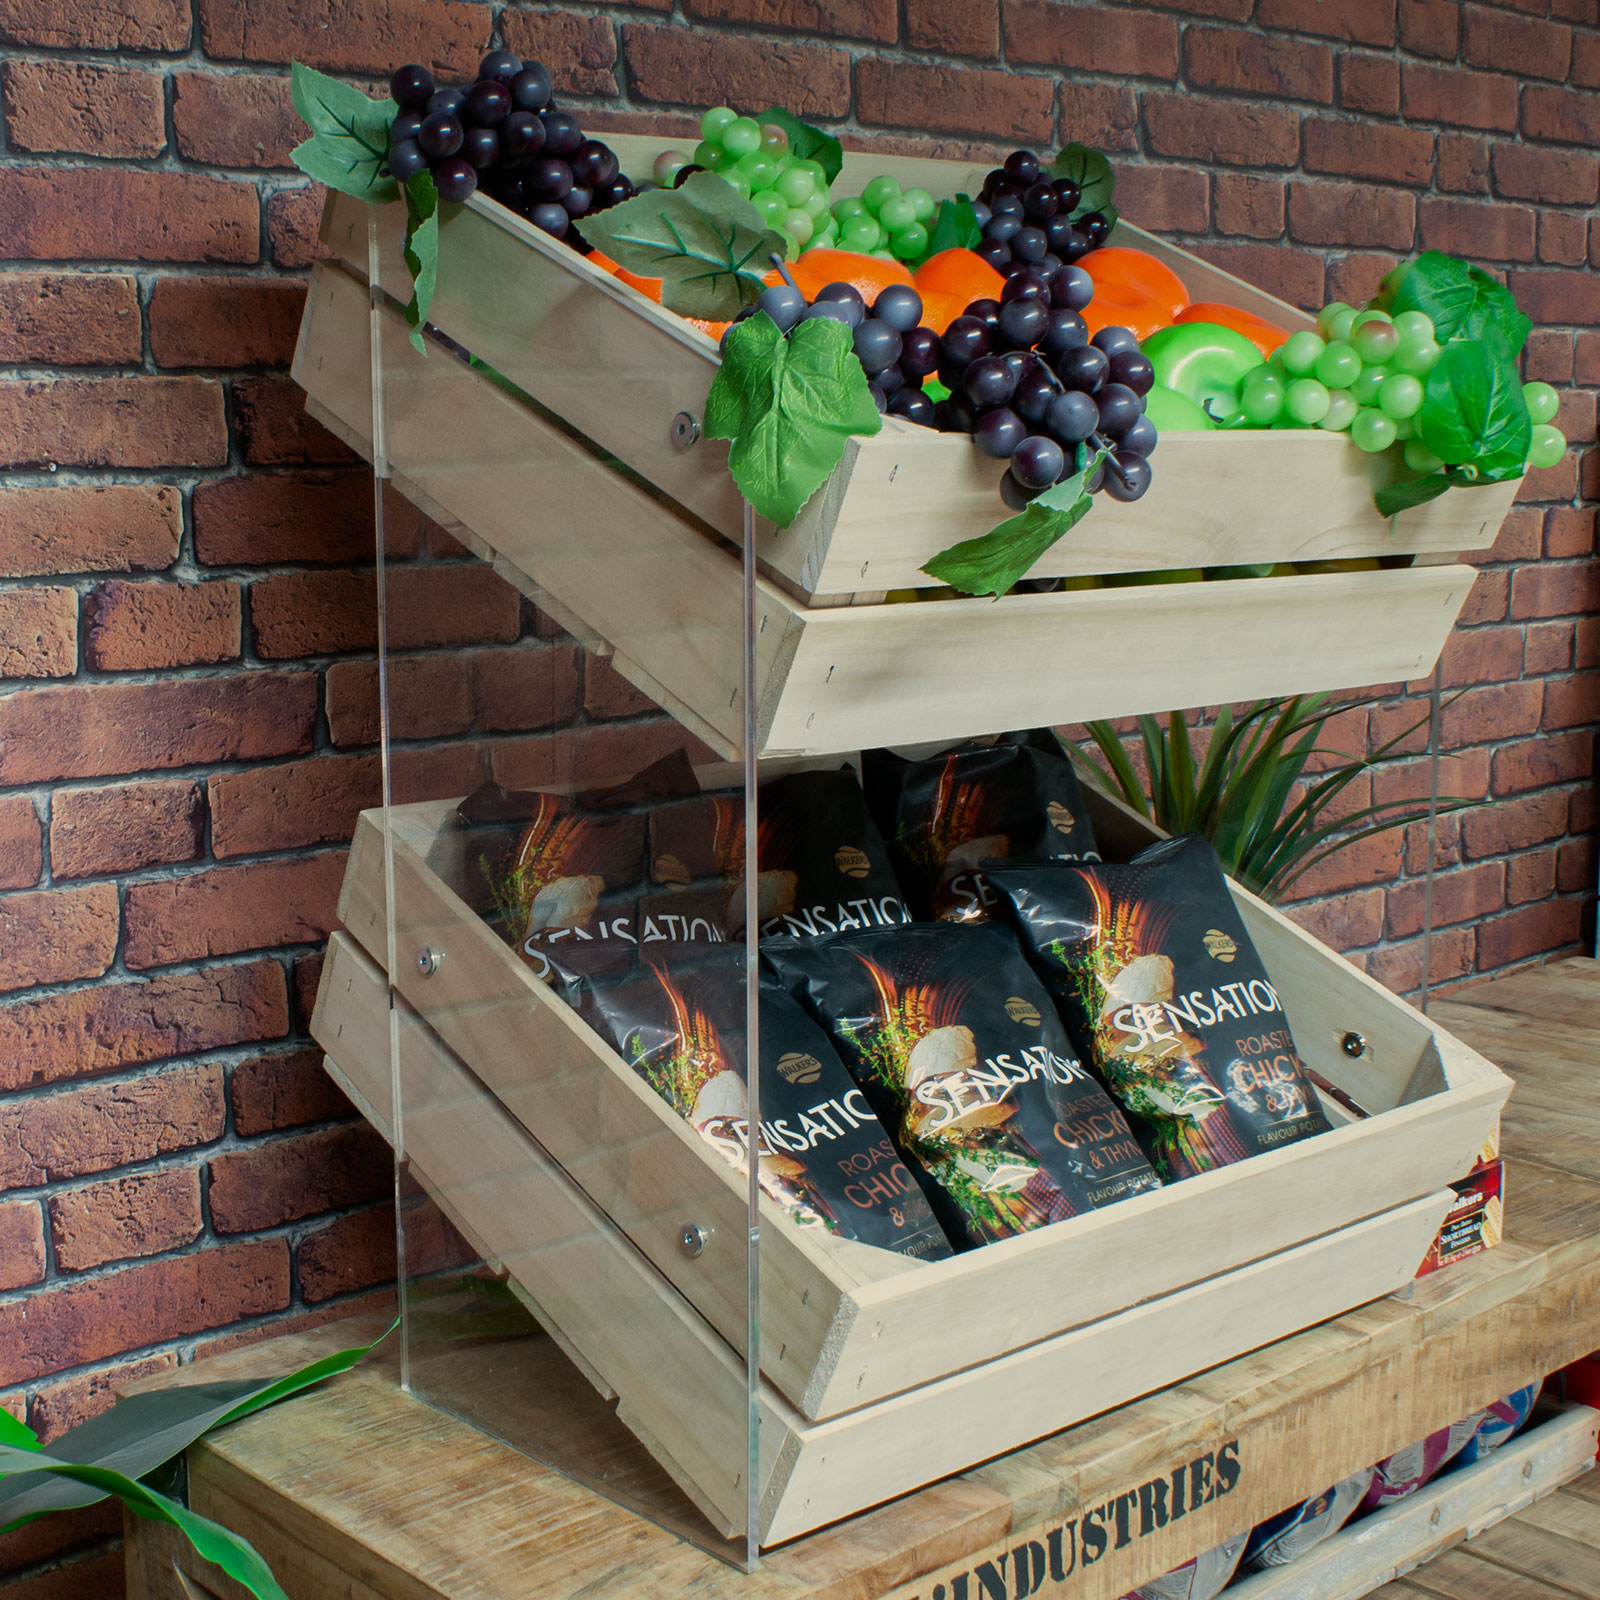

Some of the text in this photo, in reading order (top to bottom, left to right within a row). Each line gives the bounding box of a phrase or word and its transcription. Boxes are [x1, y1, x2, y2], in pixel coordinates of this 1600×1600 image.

[780, 1056, 818, 1080] WALKERS
[1265, 1093, 1278, 1112] &
[1257, 1125, 1298, 1145] FLAVOUR
[1088, 1150, 1105, 1170] &
[1086, 1182, 1127, 1203] FLAVOUR
[1448, 1192, 1483, 1214] alkers
[889, 1206, 905, 1228] &
